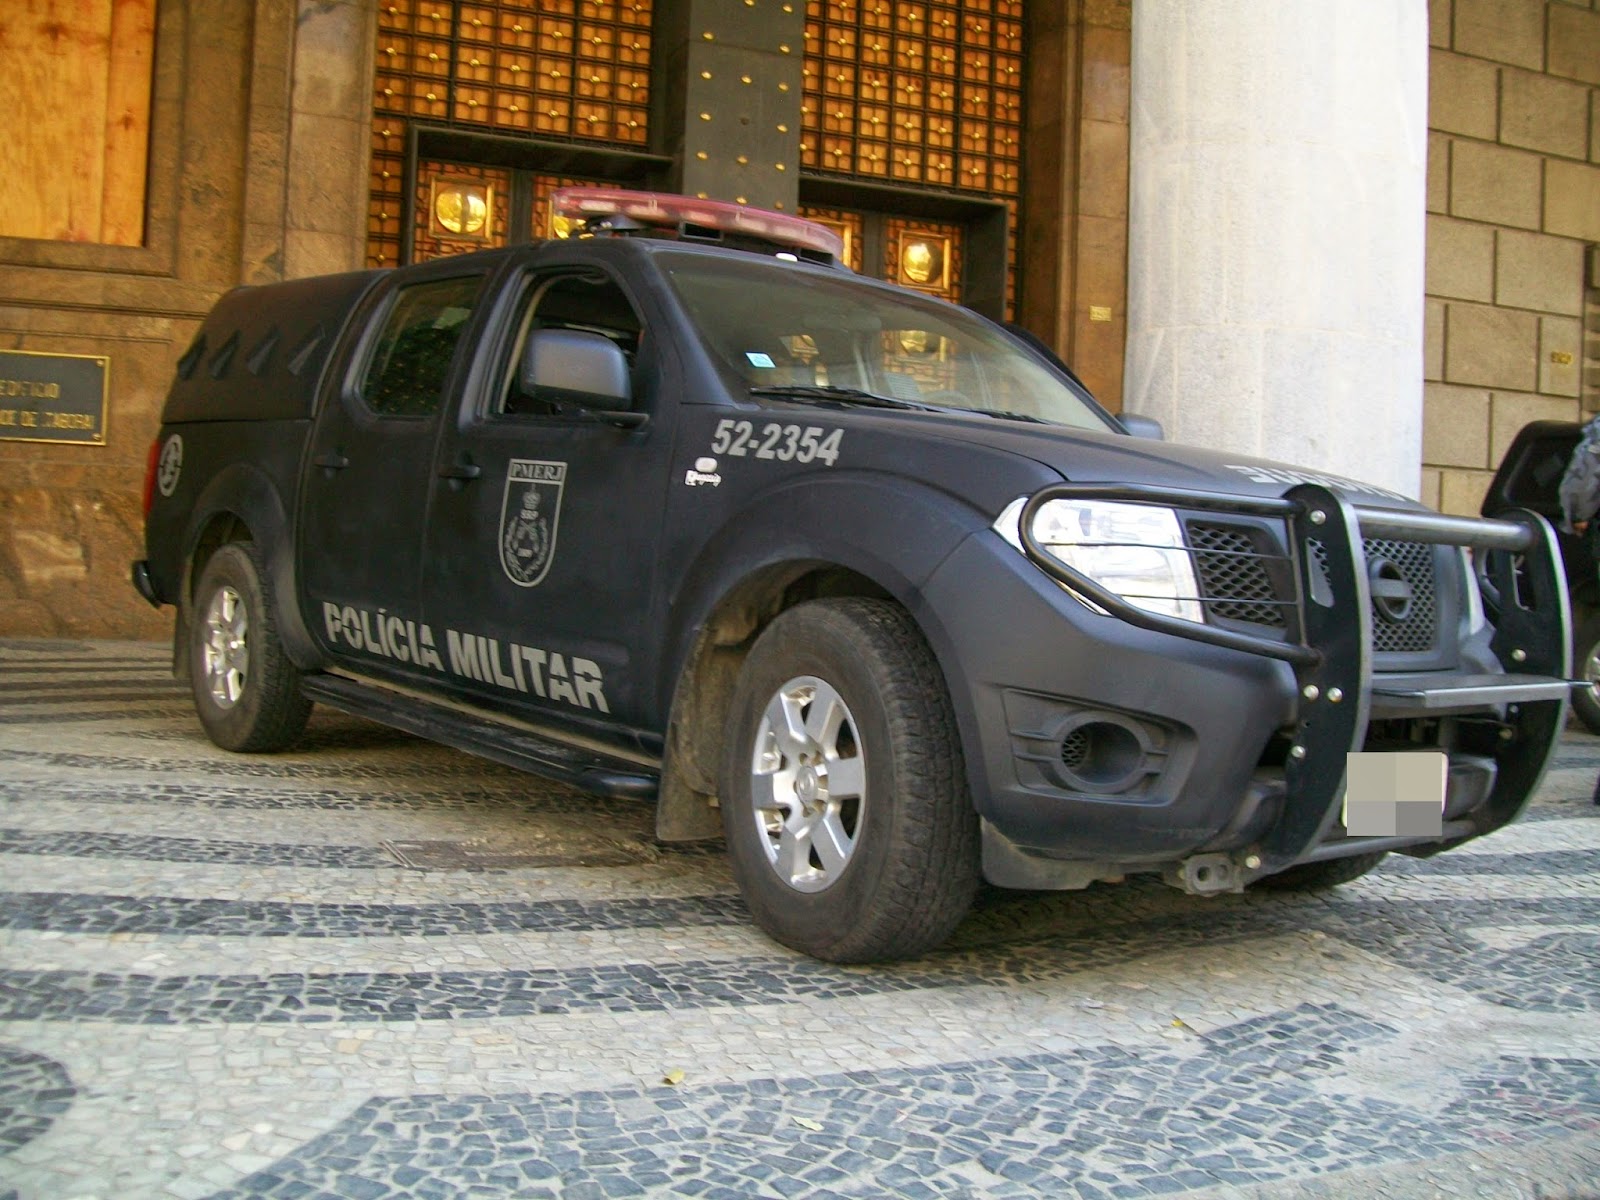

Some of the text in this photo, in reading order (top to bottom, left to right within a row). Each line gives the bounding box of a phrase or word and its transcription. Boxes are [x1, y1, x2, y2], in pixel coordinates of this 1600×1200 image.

[711, 419, 845, 467] 52-2354
[511, 463, 562, 480] PMERJ
[323, 601, 611, 714] POLÍCIA MILITAR
